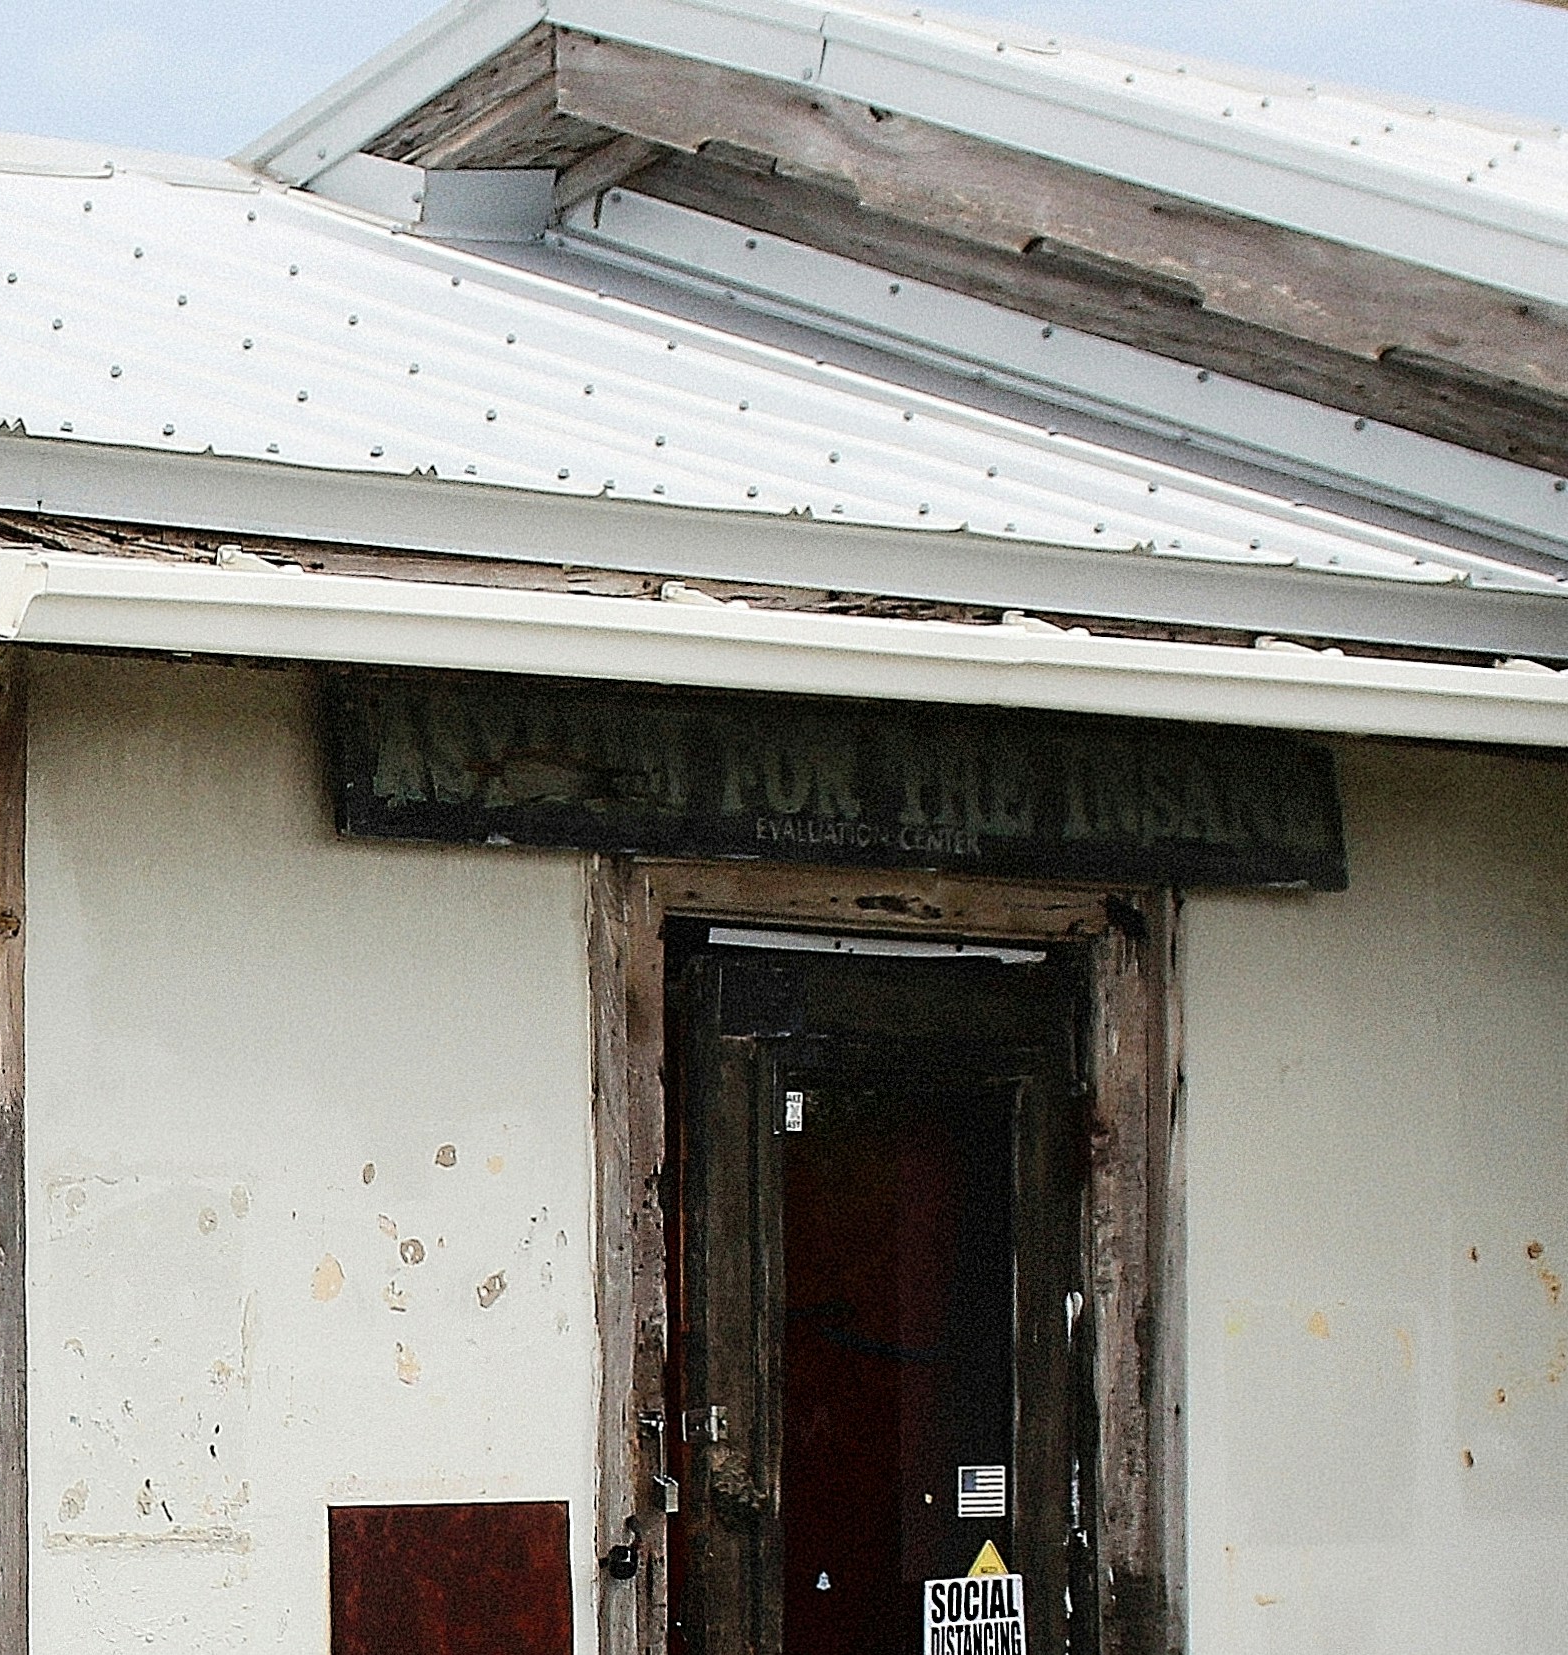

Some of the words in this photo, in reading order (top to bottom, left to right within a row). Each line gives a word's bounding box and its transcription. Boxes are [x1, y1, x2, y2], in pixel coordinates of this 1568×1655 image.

[720, 712, 861, 820] FOR
[893, 724, 1036, 836] THE
[756, 820, 889, 848] EVALUATION
[900, 828, 982, 854] CENTER
[931, 1578, 1019, 1624] SOCIAL
